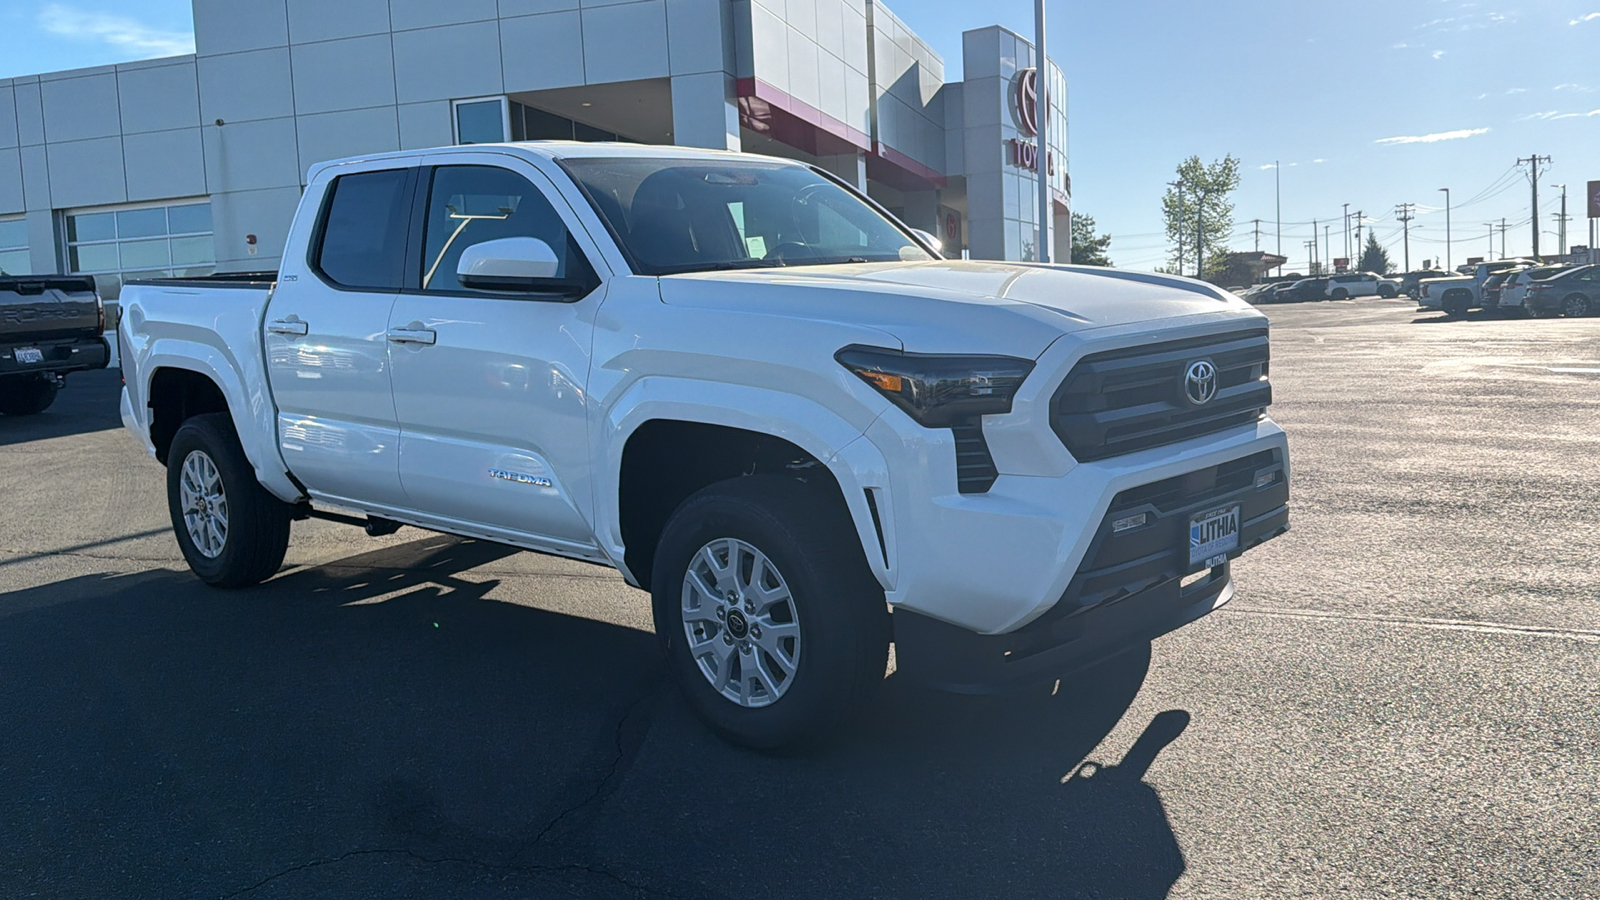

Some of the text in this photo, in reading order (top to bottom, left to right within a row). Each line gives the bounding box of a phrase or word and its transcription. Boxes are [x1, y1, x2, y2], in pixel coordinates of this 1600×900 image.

[1012, 139, 1054, 176] TOYA
[488, 469, 552, 487] TACOMA
[1200, 514, 1237, 545] LITHIA
